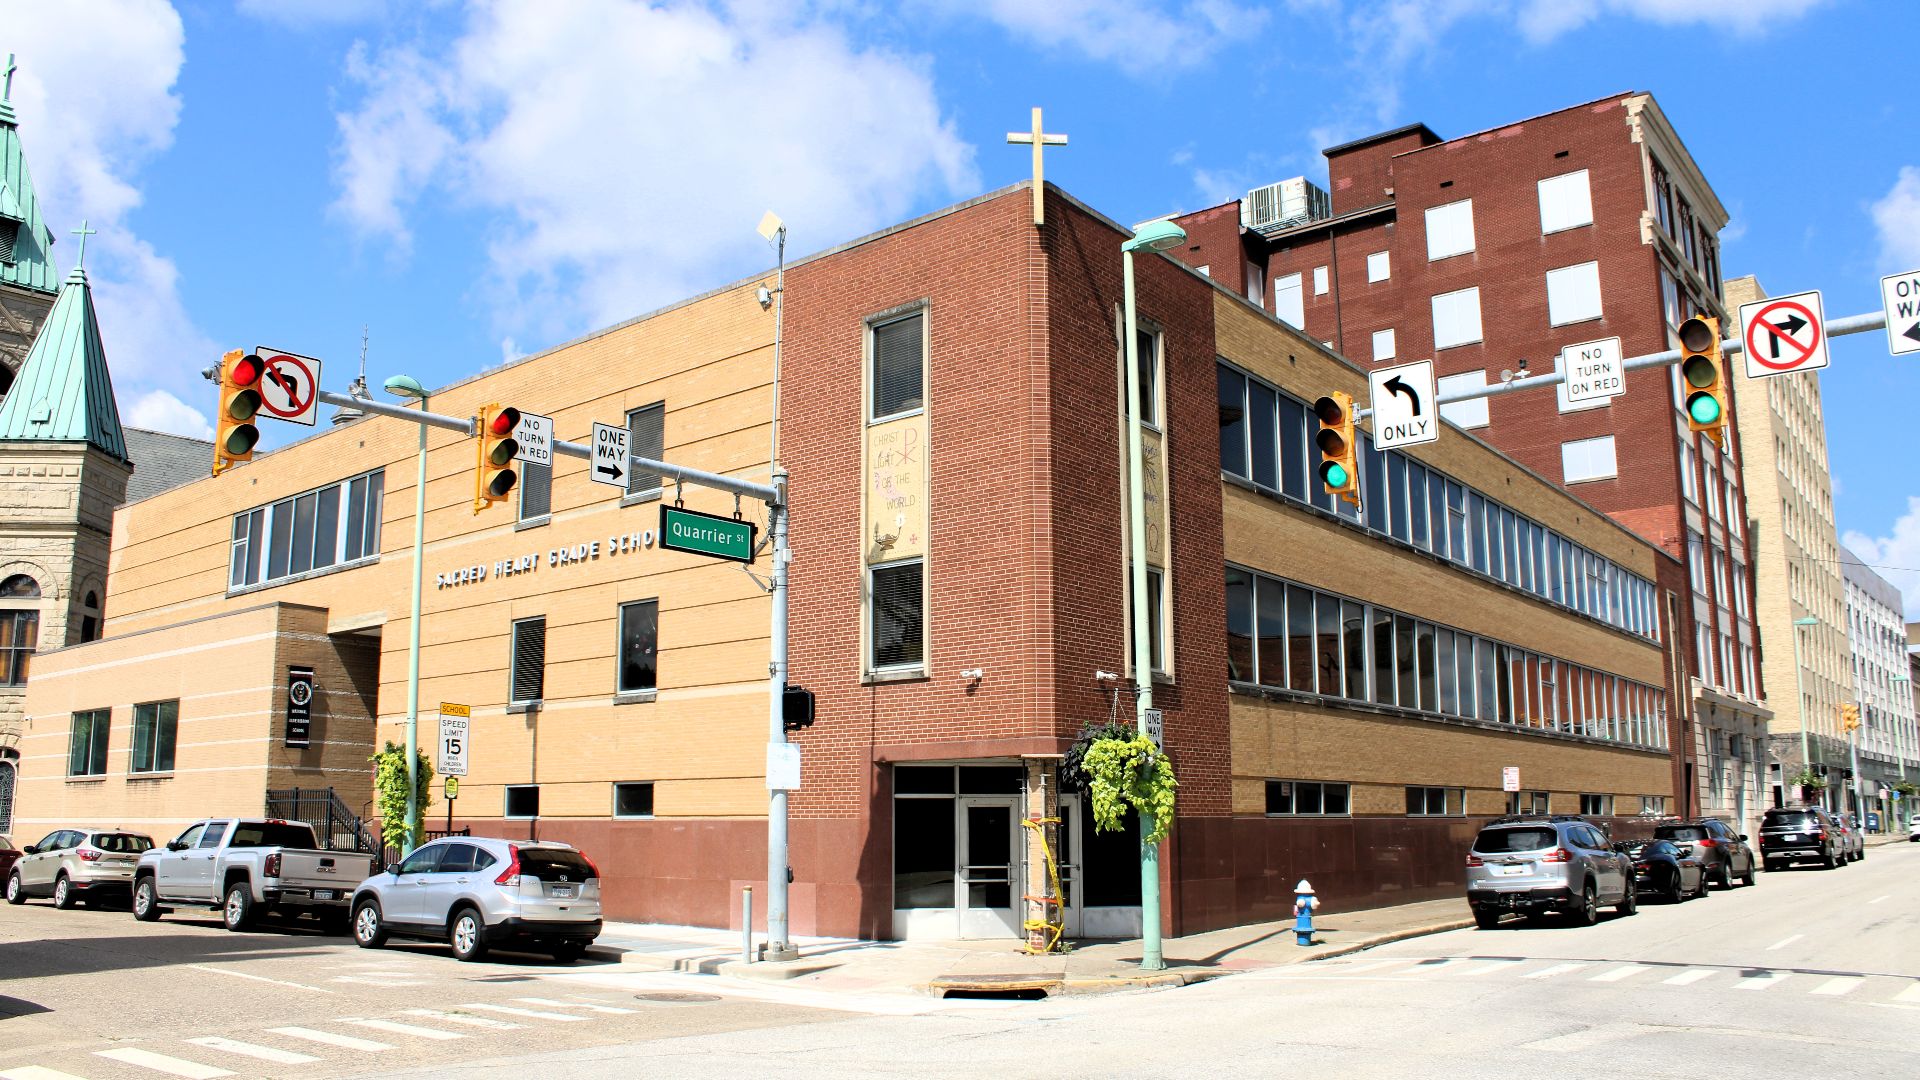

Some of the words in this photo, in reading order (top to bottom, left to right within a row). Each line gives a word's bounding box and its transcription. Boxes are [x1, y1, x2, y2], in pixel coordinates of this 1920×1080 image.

[1581, 348, 1602, 361] NO
[1577, 362, 1610, 378] TURN
[1572, 382, 1589, 395] ON
[1594, 377, 1619, 391] RED
[524, 418, 540, 431] NO
[1384, 419, 1428, 441] ONLY
[519, 431, 544, 444] TURN
[599, 428, 626, 447] ONE
[873, 431, 899, 447] CHRIST
[529, 448, 548, 460] RED
[597, 444, 626, 461] WAY
[894, 472, 910, 486] THE
[886, 494, 916, 510] WORLD
[673, 522, 732, 545] Quarrier
[736, 534, 744, 543] St
[436, 564, 487, 587] SACRED
[494, 552, 539, 576] HEART
[549, 540, 600, 566] GRADE
[442, 705, 468, 715] SCHOOL
[442, 720, 467, 729] SPEED
[1147, 713, 1160, 725] ONE
[444, 729, 463, 737] LIMIT
[1147, 726, 1161, 738] WAY
[445, 738, 461, 755] 15
